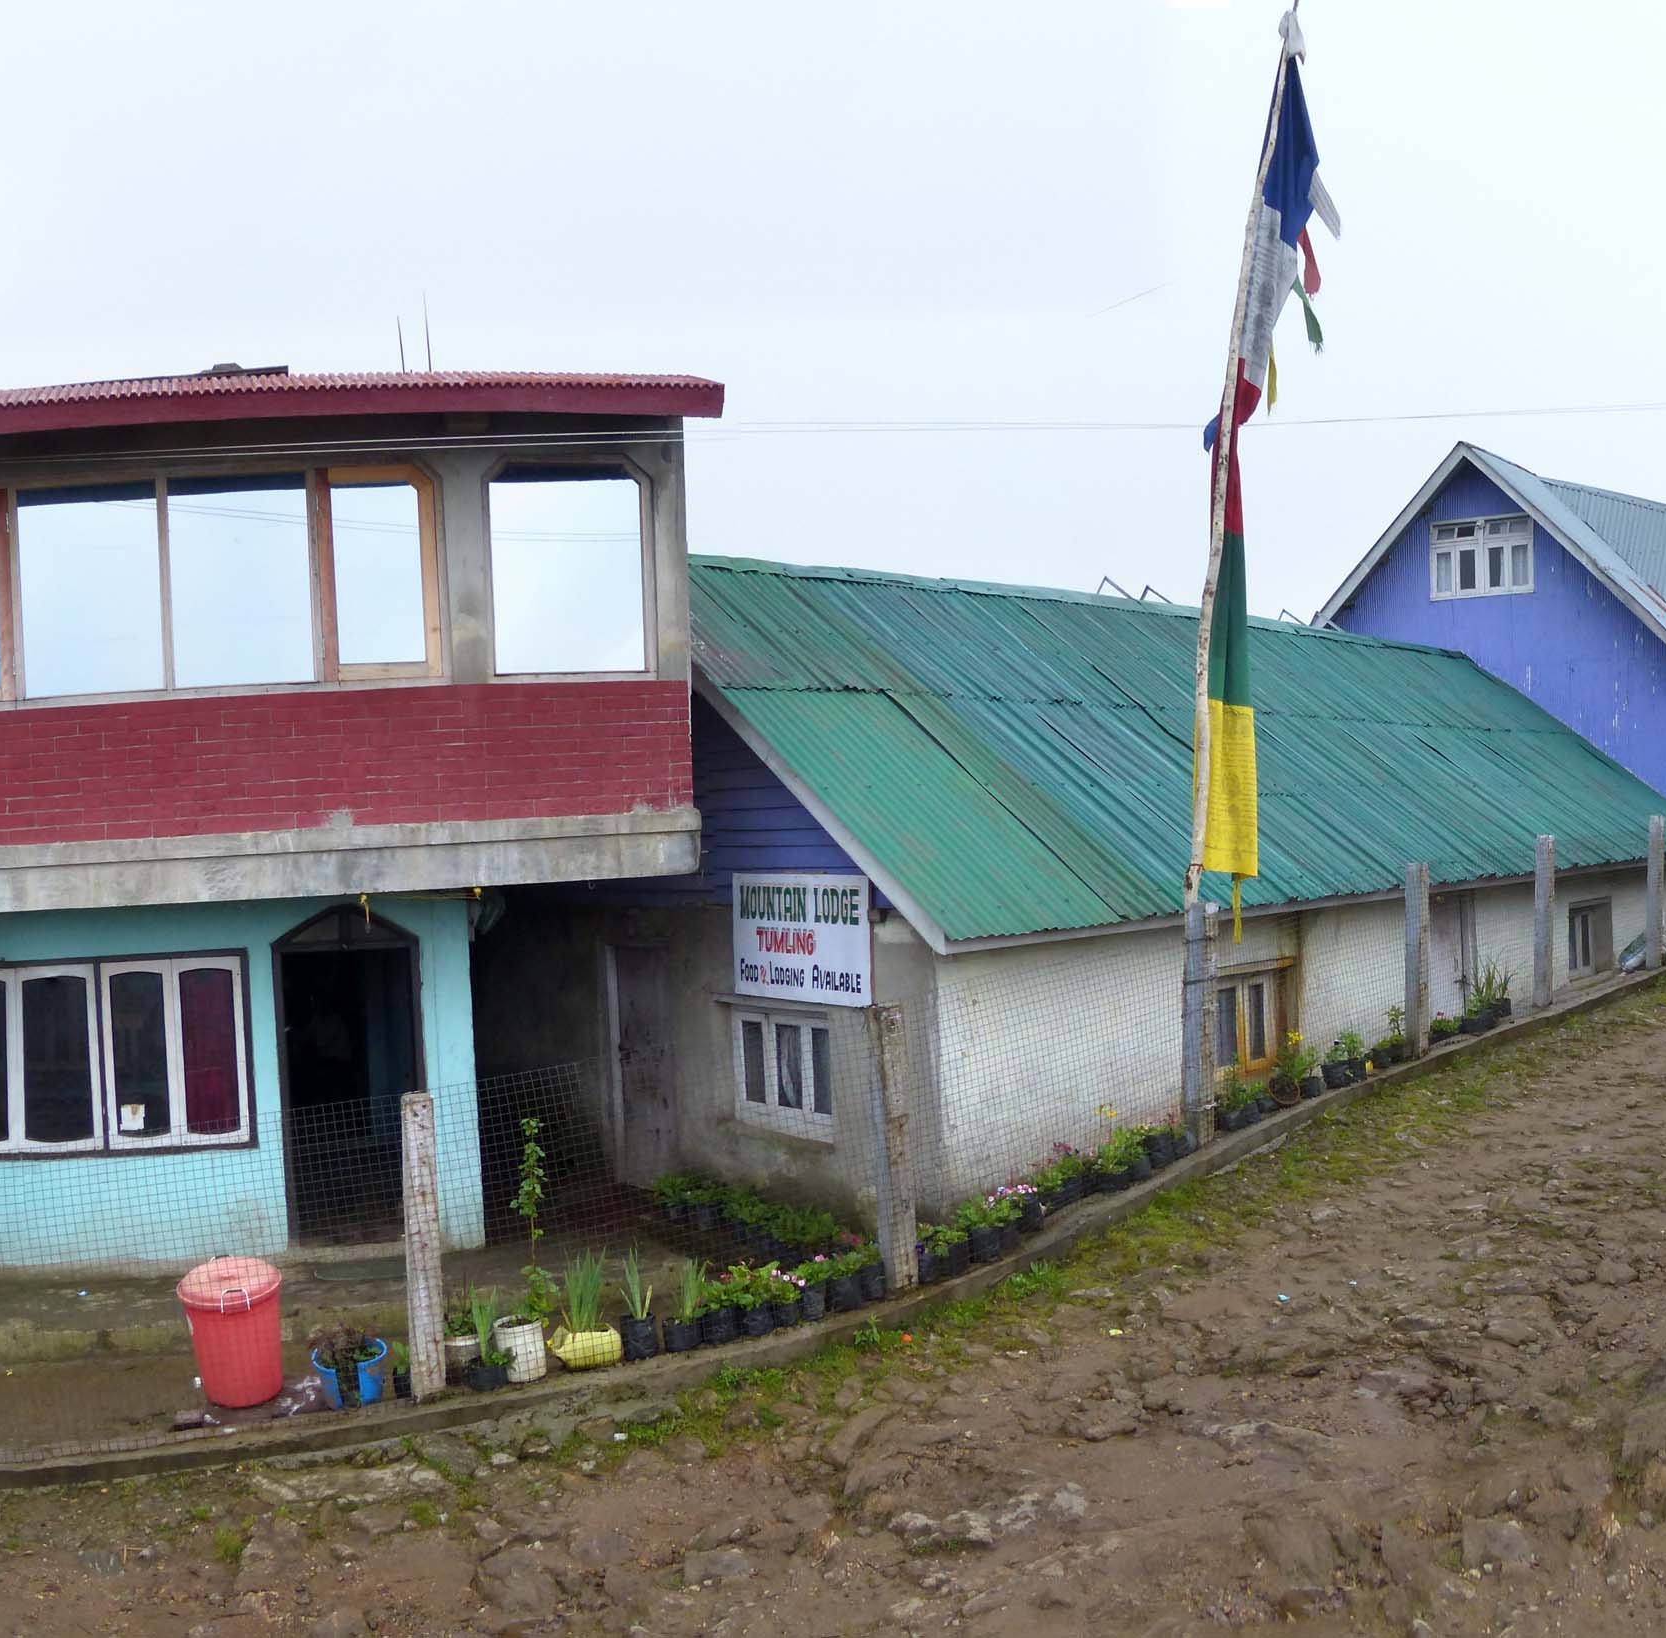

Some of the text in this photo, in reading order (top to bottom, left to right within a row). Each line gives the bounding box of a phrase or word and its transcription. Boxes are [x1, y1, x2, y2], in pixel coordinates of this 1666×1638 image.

[740, 884, 860, 925] MOUNTAIN LODGE
[756, 927, 815, 955] TUMLING
[740, 958, 759, 982] FOOD
[770, 960, 804, 987] LODGING
[812, 964, 861, 993] AVAILABLE
